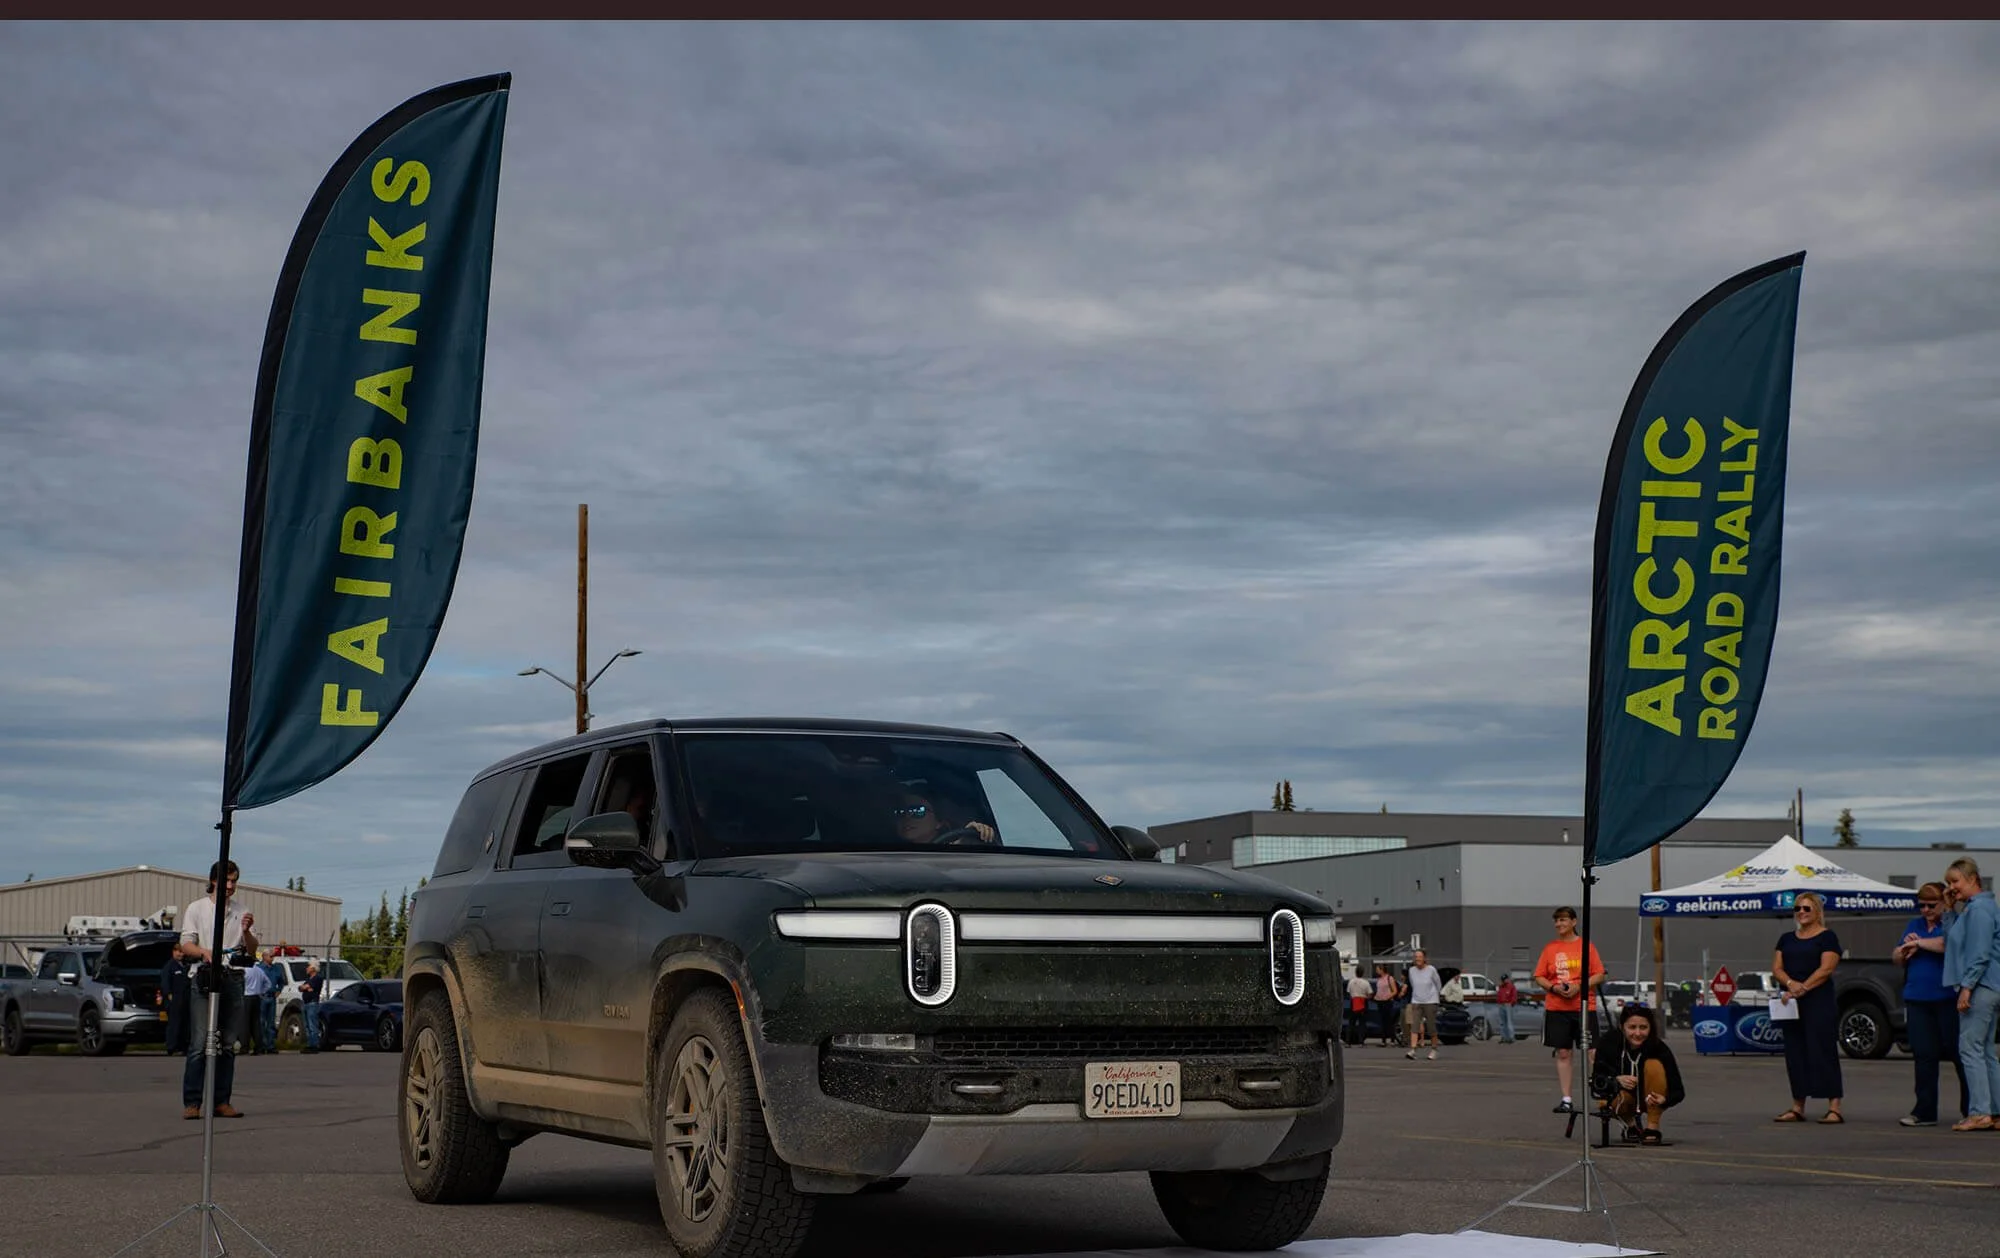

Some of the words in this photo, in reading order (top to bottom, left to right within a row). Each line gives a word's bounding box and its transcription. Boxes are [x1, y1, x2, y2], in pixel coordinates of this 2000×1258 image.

[319, 157, 432, 727] FAIRBANKS
[1710, 416, 1759, 575] RALLY
[1625, 416, 1706, 736] ARCTIC
[1697, 592, 1745, 740] ROAD
[1675, 896, 1762, 913] seekins.com
[1835, 893, 1915, 909] seekins.com
[1751, 1015, 1785, 1042] For
[1105, 1066, 1159, 1082] California
[1092, 1083, 1175, 1110] 9CED410
